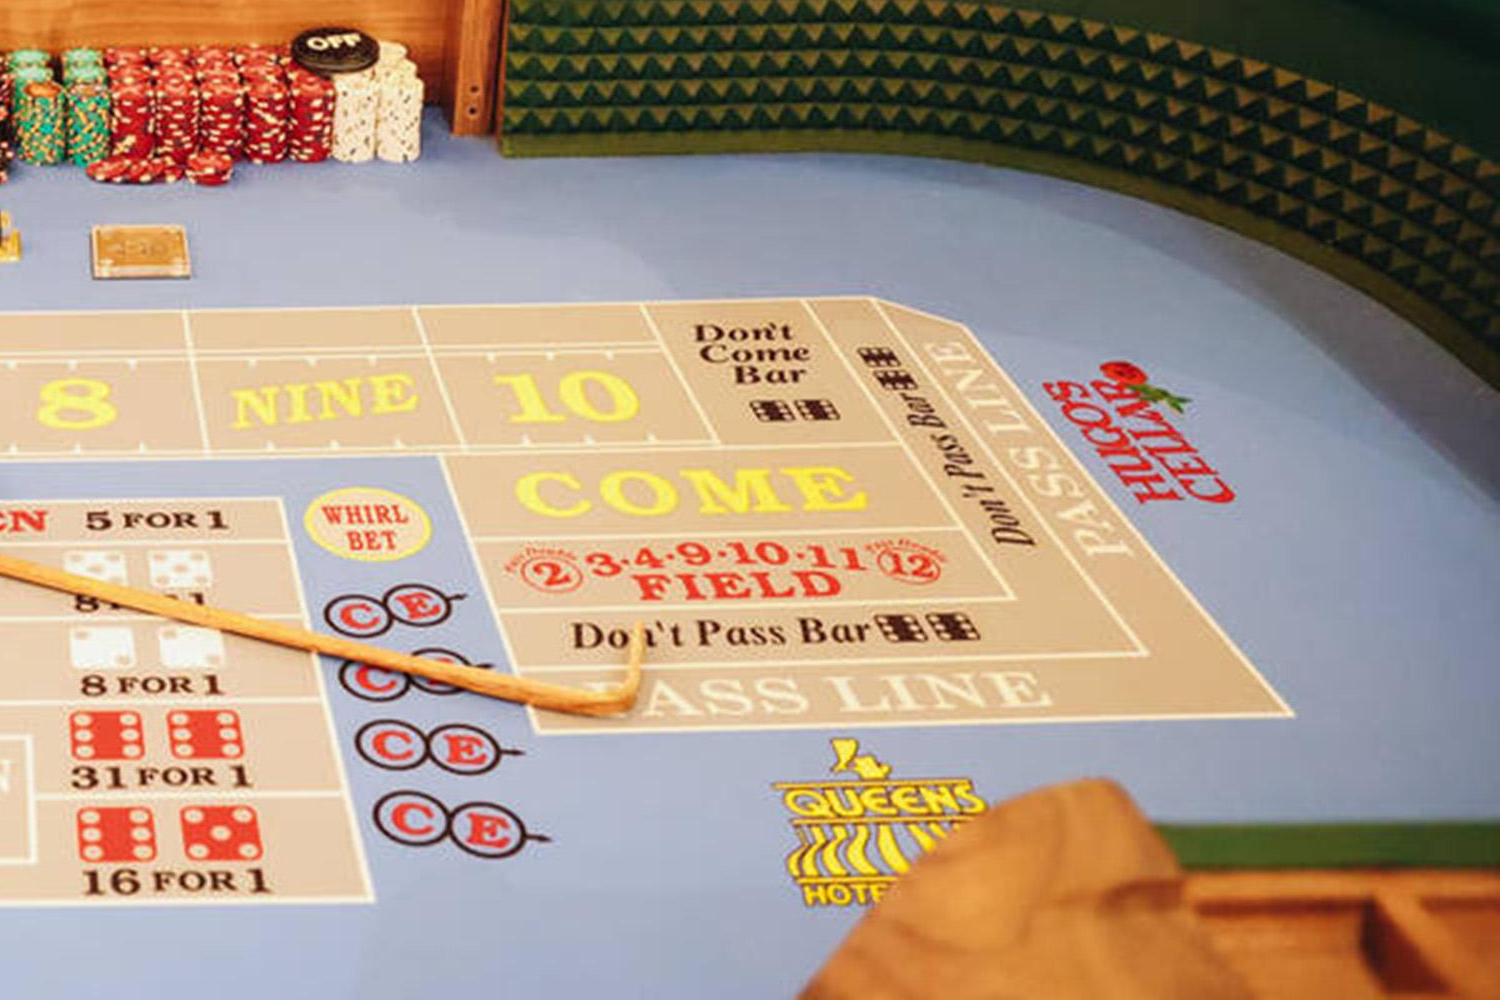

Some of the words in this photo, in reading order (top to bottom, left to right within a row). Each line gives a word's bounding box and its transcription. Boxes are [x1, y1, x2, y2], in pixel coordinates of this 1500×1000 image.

[307, 32, 361, 51] OFF
[694, 323, 794, 343] Don't
[700, 344, 811, 365] Come
[732, 365, 807, 386] Bar
[926, 340, 1035, 435] LINE
[35, 377, 119, 430] 8
[230, 371, 420, 430] NINE
[493, 369, 641, 424] 10
[900, 392, 948, 428] Bar
[930, 434, 986, 480] Pass
[1089, 380, 1237, 504] CELLAR
[514, 465, 871, 518] COME
[1010, 445, 1134, 557] PASS
[85, 511, 112, 531] 5
[122, 512, 200, 530] FOR
[206, 510, 231, 530] 1
[321, 504, 410, 525] WHIRL
[961, 484, 1036, 546] Don't
[346, 530, 400, 551] BET
[533, 562, 572, 587] 2
[888, 552, 934, 578] 12
[633, 569, 845, 602] FIELD
[339, 603, 382, 631] C
[398, 591, 441, 621] E
[696, 618, 787, 648] Pass
[799, 617, 874, 645] Bar
[80, 675, 108, 697] 8
[118, 676, 194, 694] FOR
[202, 675, 225, 696] 1
[355, 665, 398, 694] C
[825, 669, 1054, 712] LINE
[371, 729, 415, 761] C
[443, 733, 489, 766] E
[70, 765, 129, 790] 31
[136, 767, 217, 787] FOR
[229, 765, 254, 788] 1
[783, 784, 988, 819] QUEENS
[390, 802, 435, 836] C
[466, 812, 512, 849] E
[82, 869, 142, 896] 16
[152, 871, 241, 893] FOR
[246, 868, 274, 894] 1
